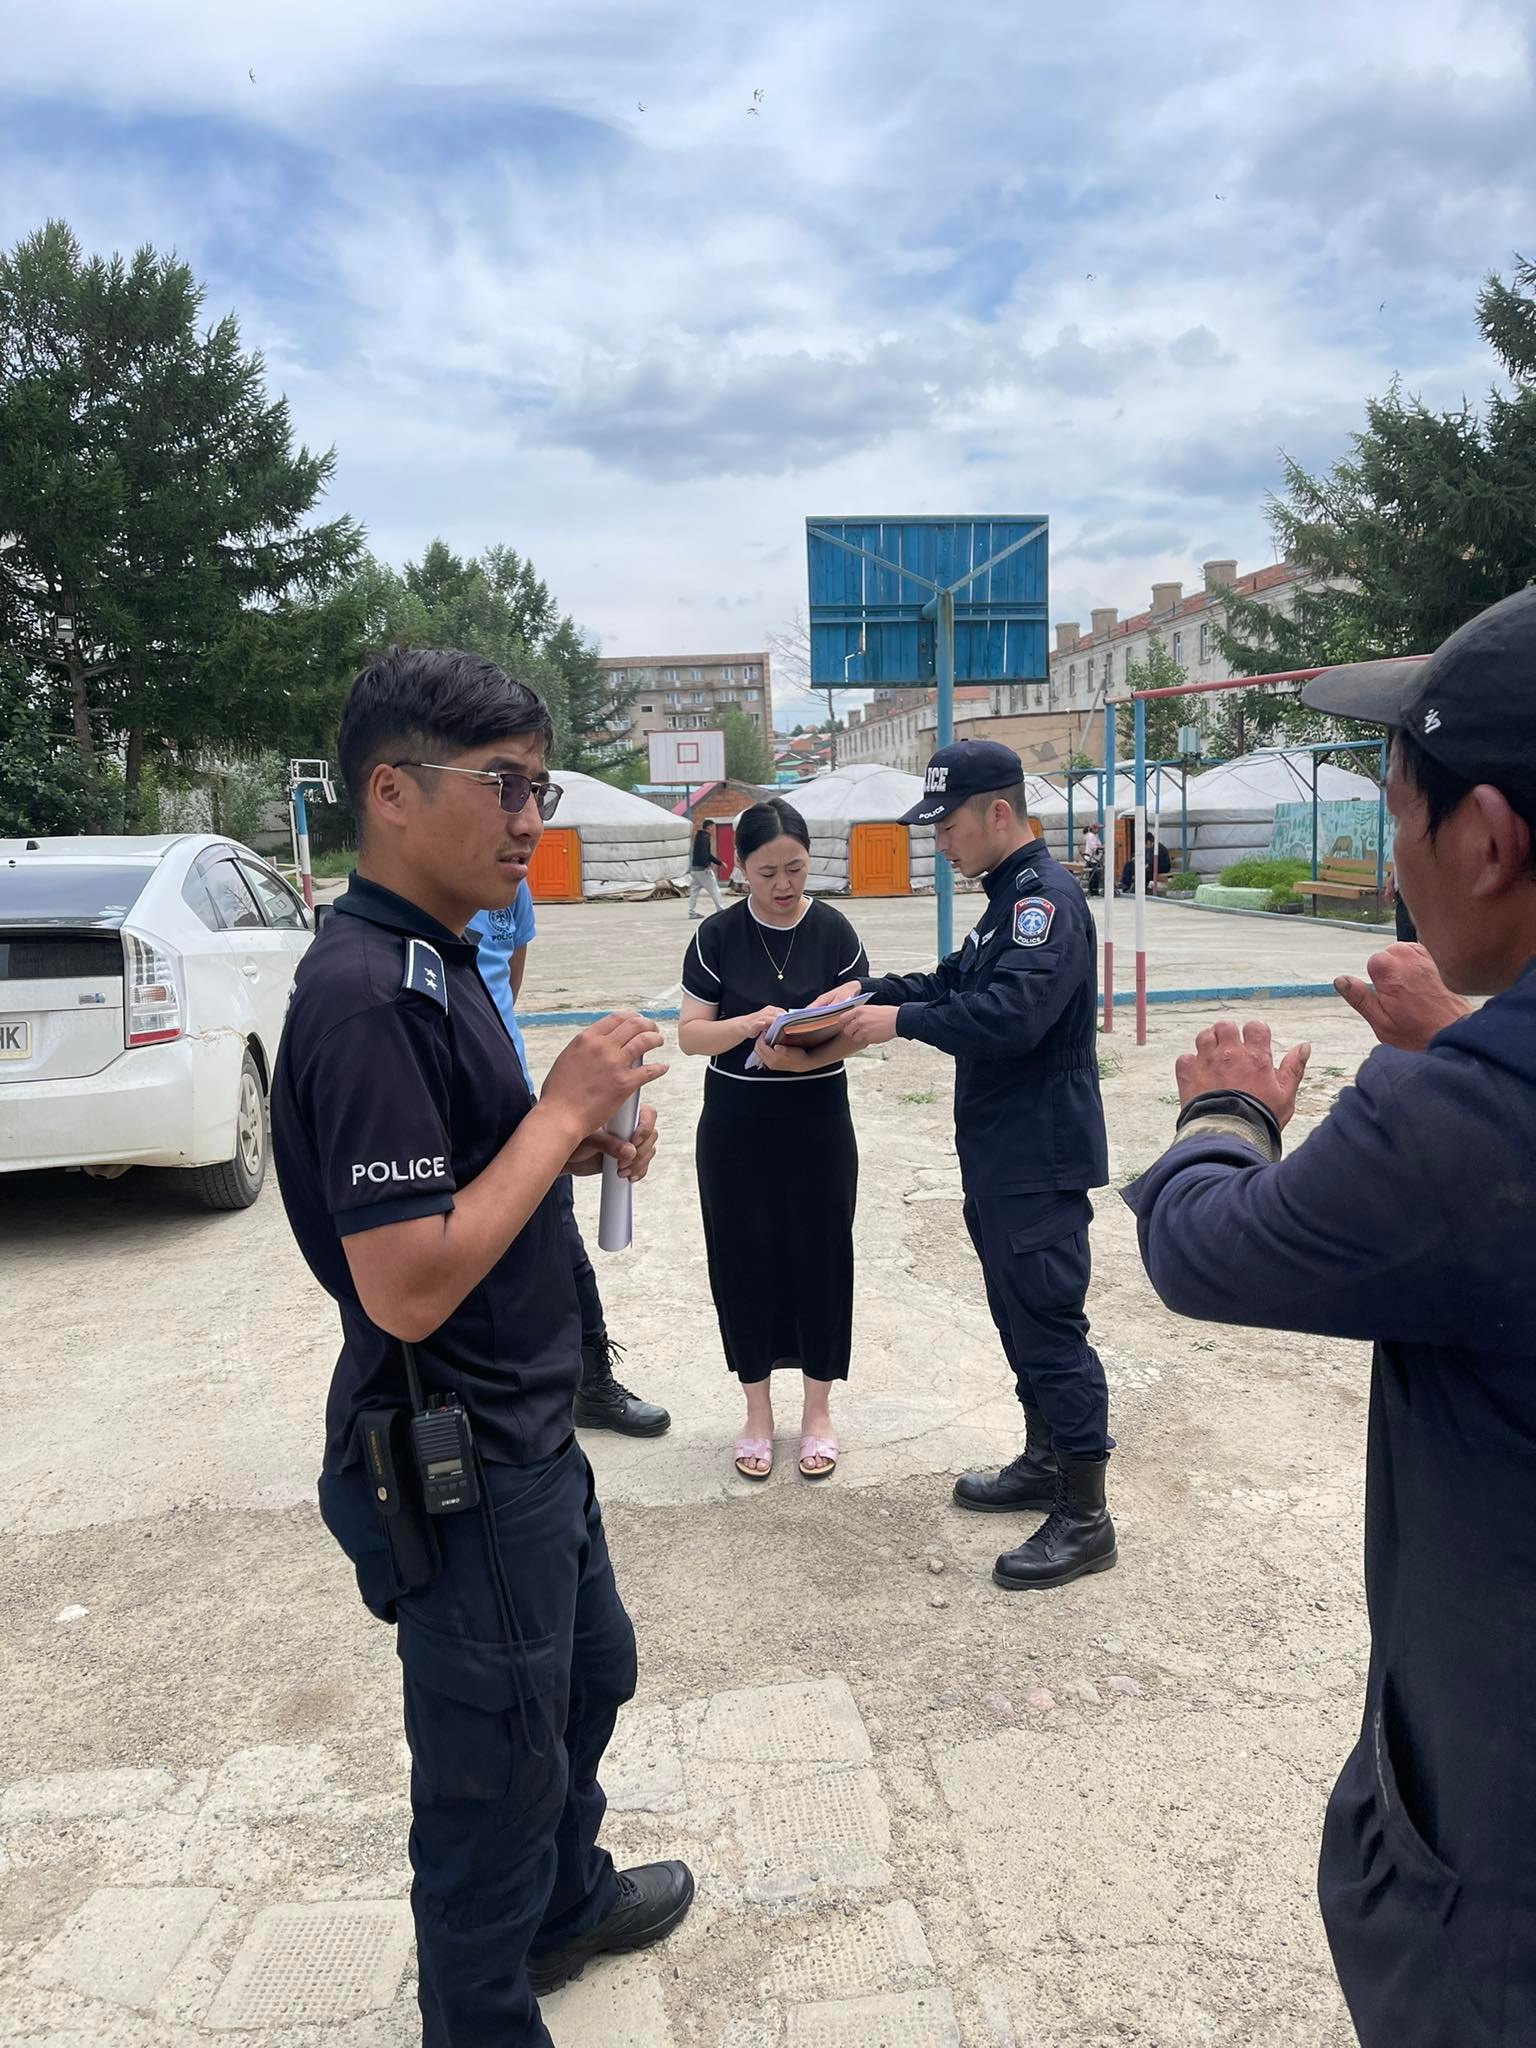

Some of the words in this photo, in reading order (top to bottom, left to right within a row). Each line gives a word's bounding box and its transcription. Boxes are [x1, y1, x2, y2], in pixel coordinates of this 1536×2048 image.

[924, 767, 949, 792] ICE
[919, 805, 945, 819] POLICE
[491, 932, 513, 941] POLIC
[1018, 935, 1041, 944] POLICE
[351, 1156, 446, 1186] POLICE
